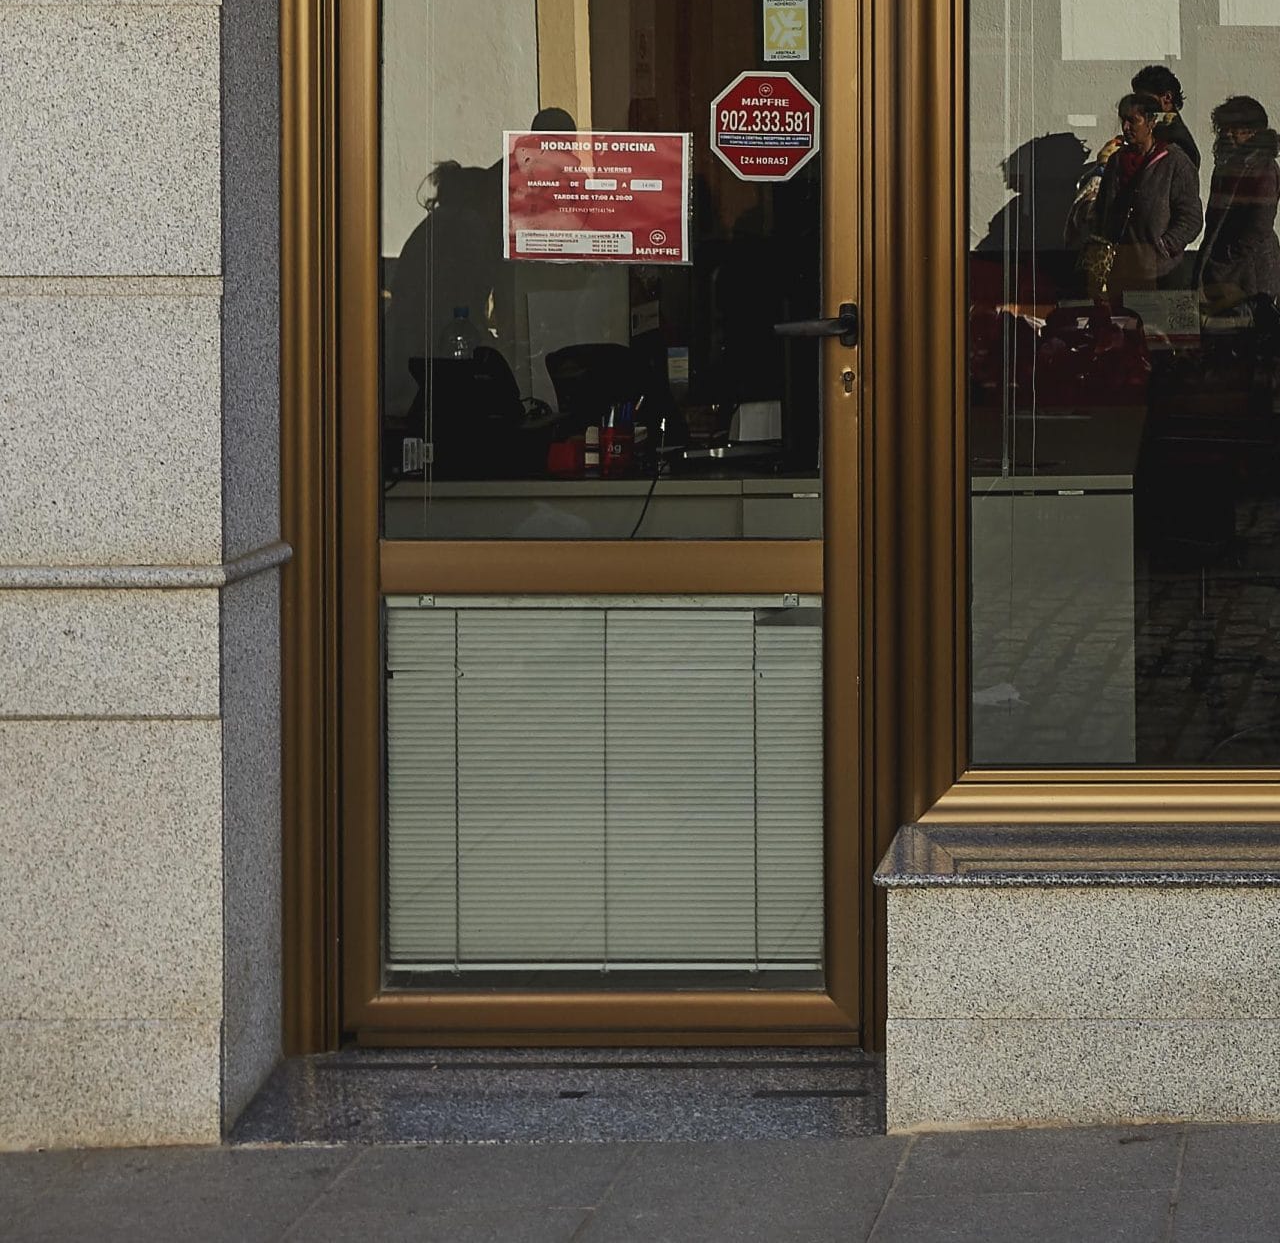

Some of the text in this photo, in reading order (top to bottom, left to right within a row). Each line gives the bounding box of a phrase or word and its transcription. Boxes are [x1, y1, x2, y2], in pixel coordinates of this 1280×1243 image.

[741, 98, 789, 107] MAPFRE
[720, 110, 810, 132] 902.333.581
[540, 141, 656, 152] HORARIO DE OFICINA
[527, 179, 560, 187] MAÑANAS
[635, 247, 680, 256] MAPFRE
